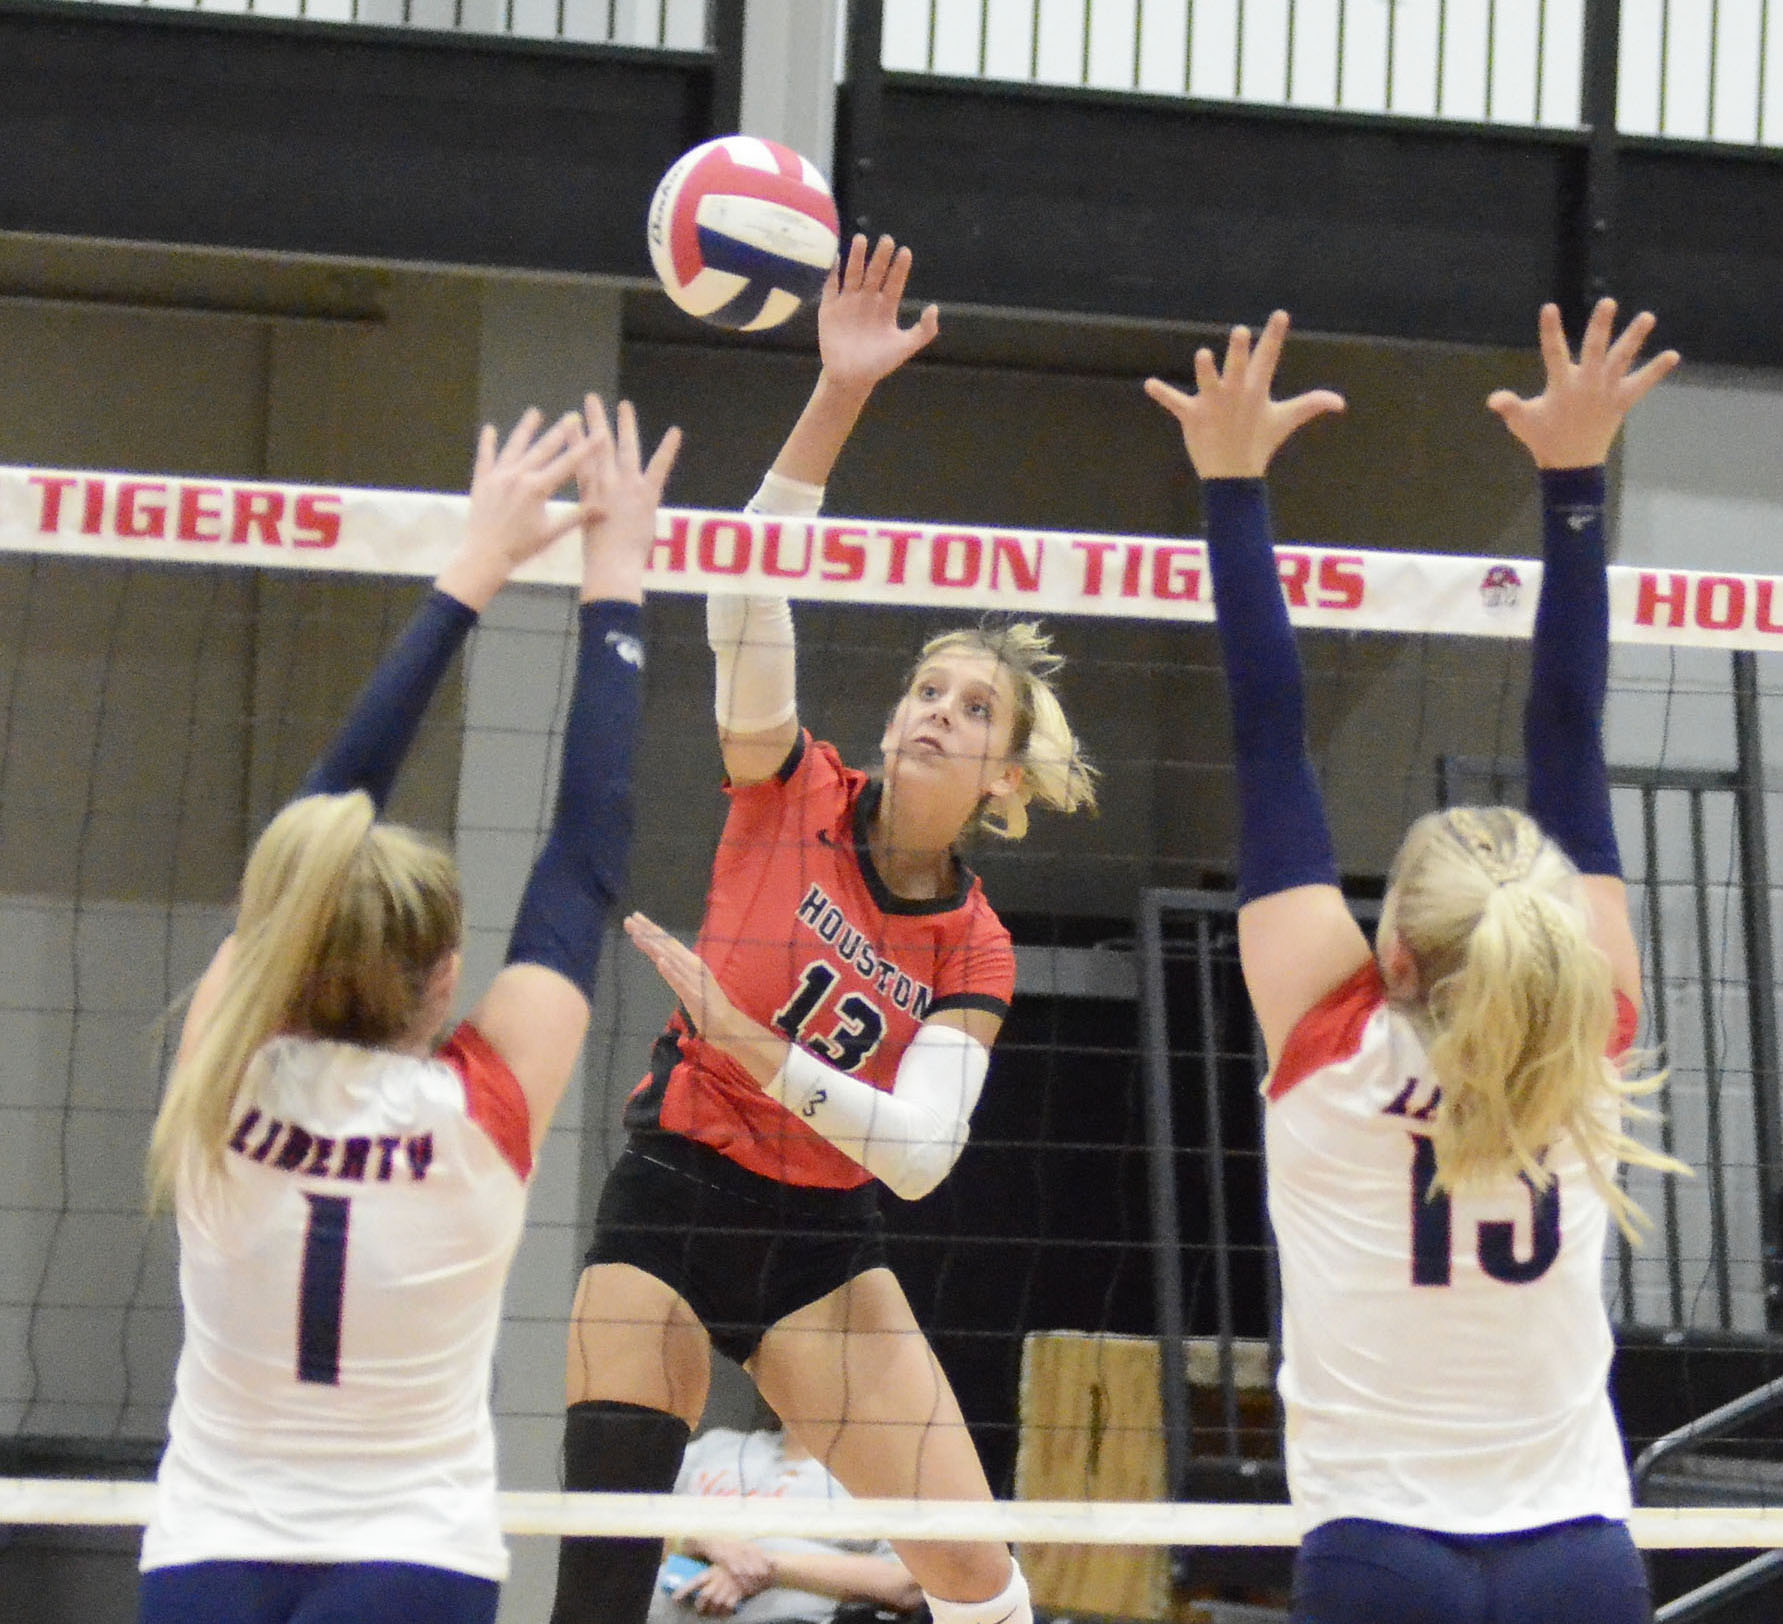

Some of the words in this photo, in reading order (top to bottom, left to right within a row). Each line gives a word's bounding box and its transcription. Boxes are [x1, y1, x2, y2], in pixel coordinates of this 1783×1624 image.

[28, 475, 343, 550] TIGERS
[645, 516, 1044, 593] HOUSTON
[1071, 540, 1366, 610] TIGRS
[795, 881, 933, 1023] HOUSTON
[771, 959, 888, 1073] 13
[227, 1104, 434, 1183] LIBERTY
[297, 1190, 351, 1386] 1
